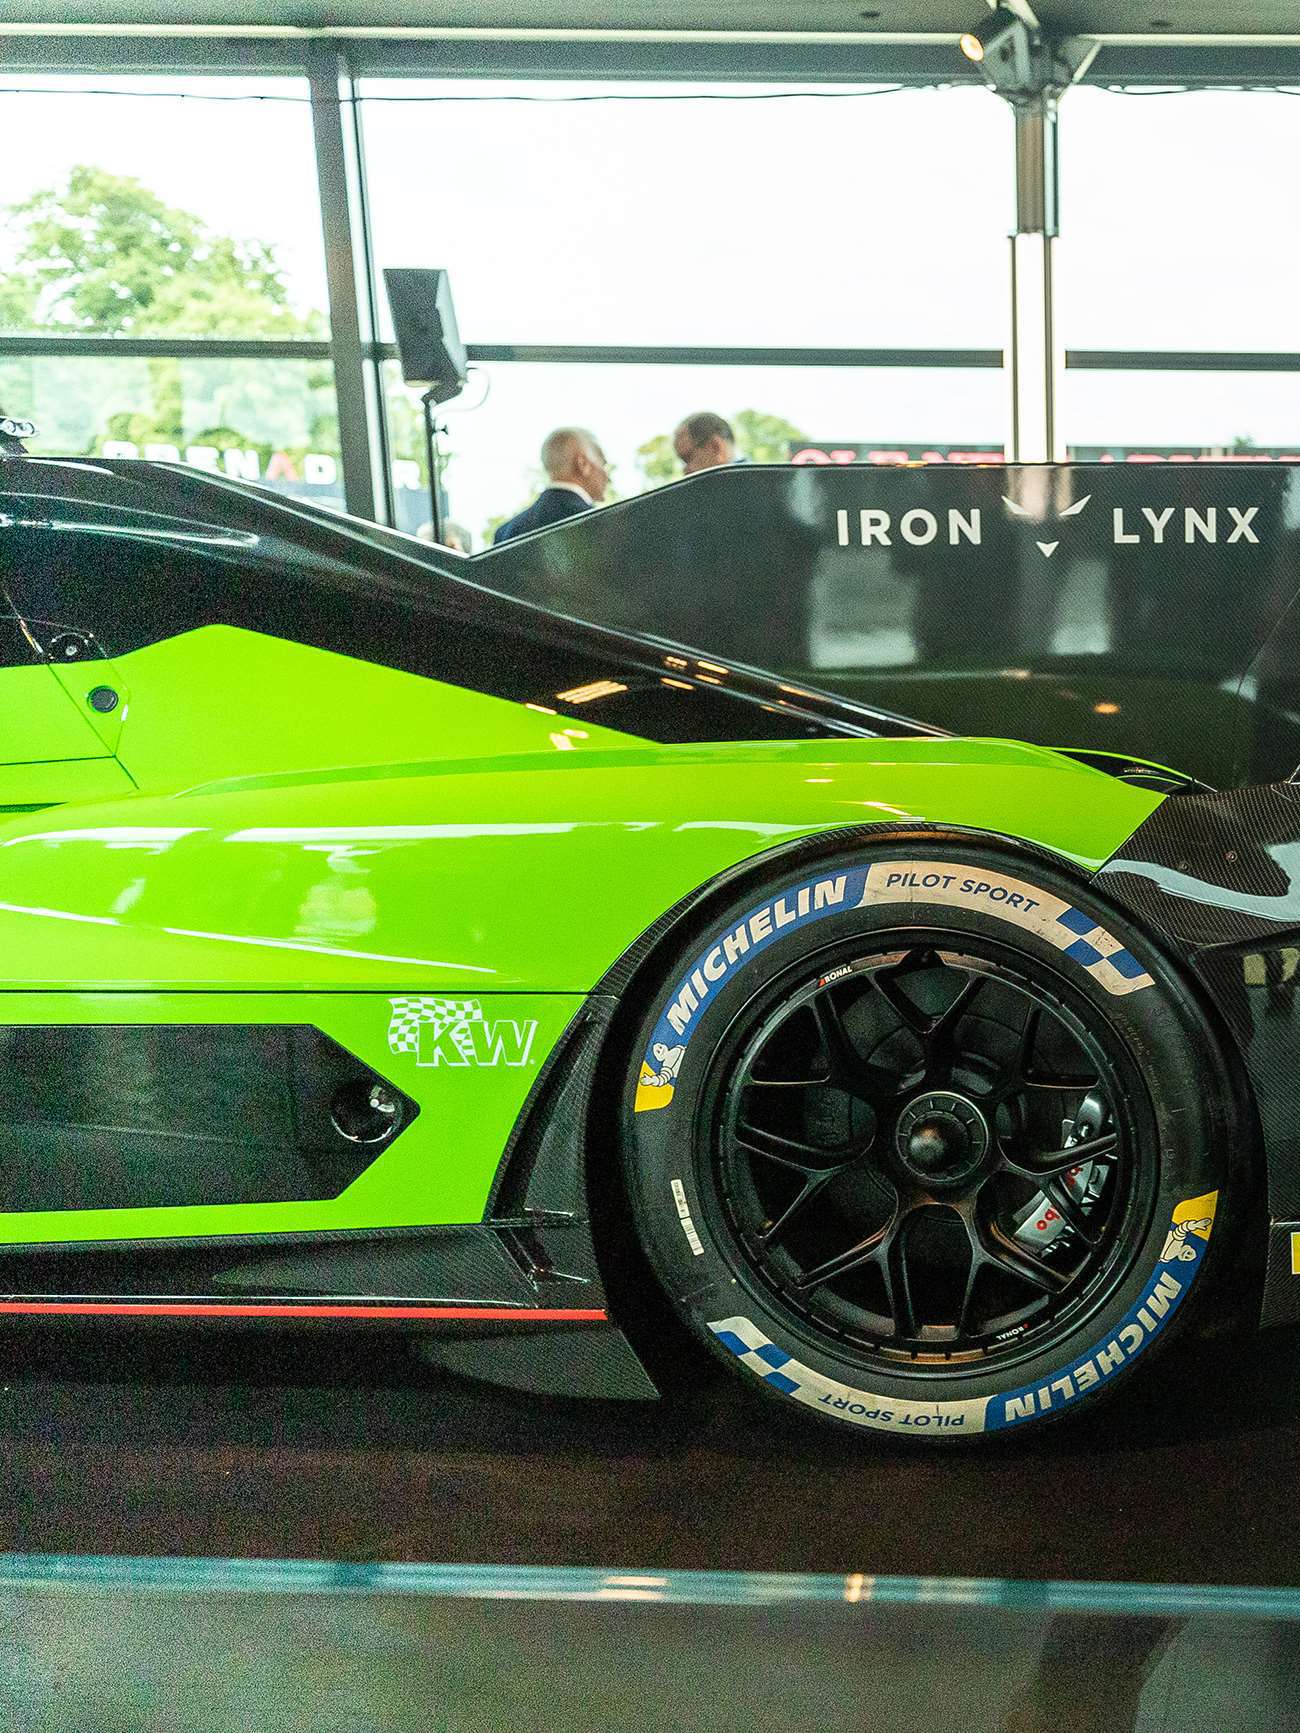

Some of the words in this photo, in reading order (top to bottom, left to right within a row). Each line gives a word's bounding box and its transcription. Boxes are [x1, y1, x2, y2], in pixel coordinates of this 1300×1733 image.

[836, 508, 982, 546] IRON
[1113, 507, 1260, 544] LYNX
[886, 873, 957, 889] PILOT
[960, 879, 1040, 913] SPORT
[667, 876, 847, 1036] MICHELIN
[824, 965, 853, 984] RONAL
[416, 1019, 538, 1067] KW
[1005, 1271, 1182, 1422] MICHELIN
[818, 1393, 895, 1422] SPORT
[898, 1414, 965, 1427] PILOT
